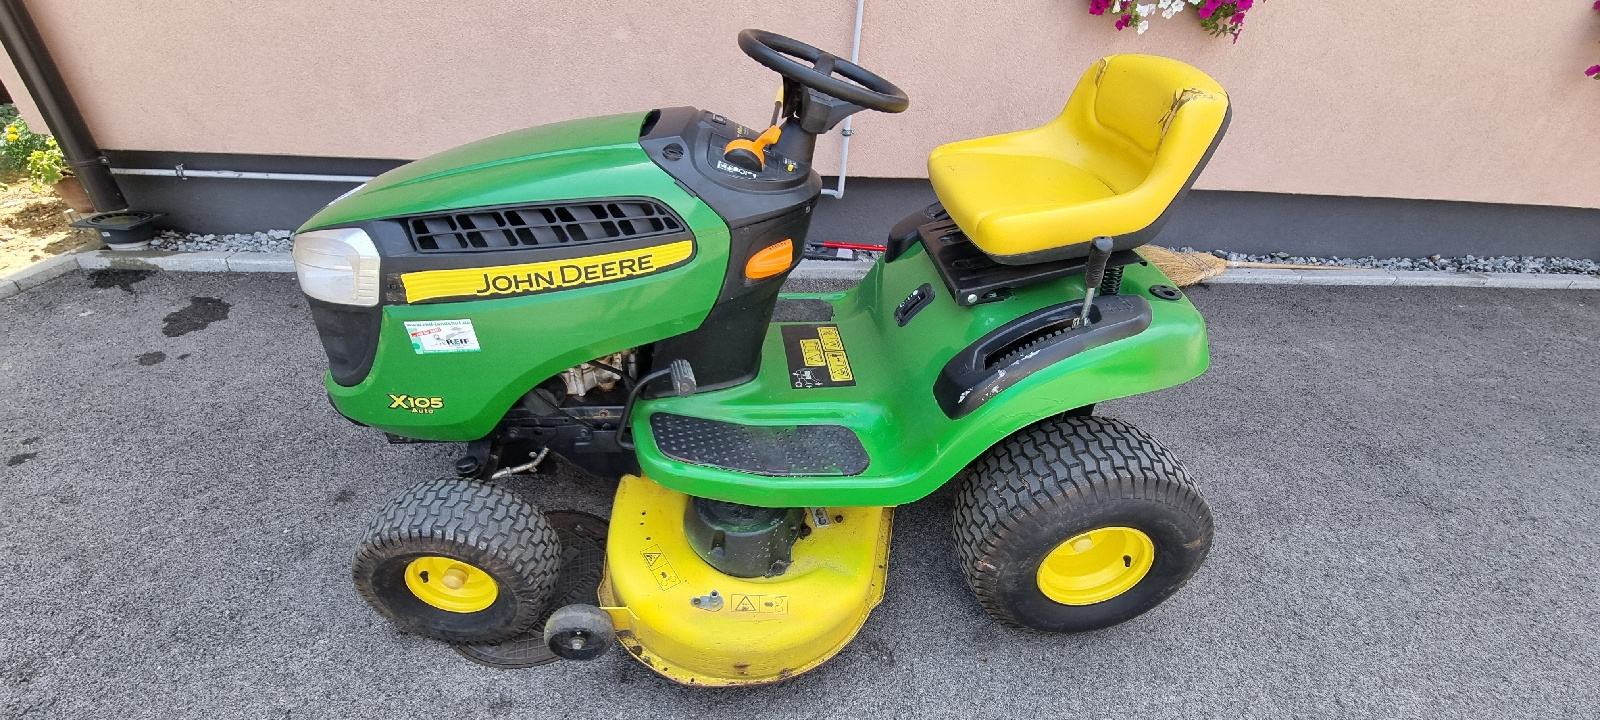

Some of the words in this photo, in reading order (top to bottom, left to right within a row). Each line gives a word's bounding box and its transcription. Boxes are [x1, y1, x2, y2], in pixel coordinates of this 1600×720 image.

[476, 270, 554, 294] JOHN
[560, 254, 654, 285] DEERE
[387, 394, 445, 409] X105
